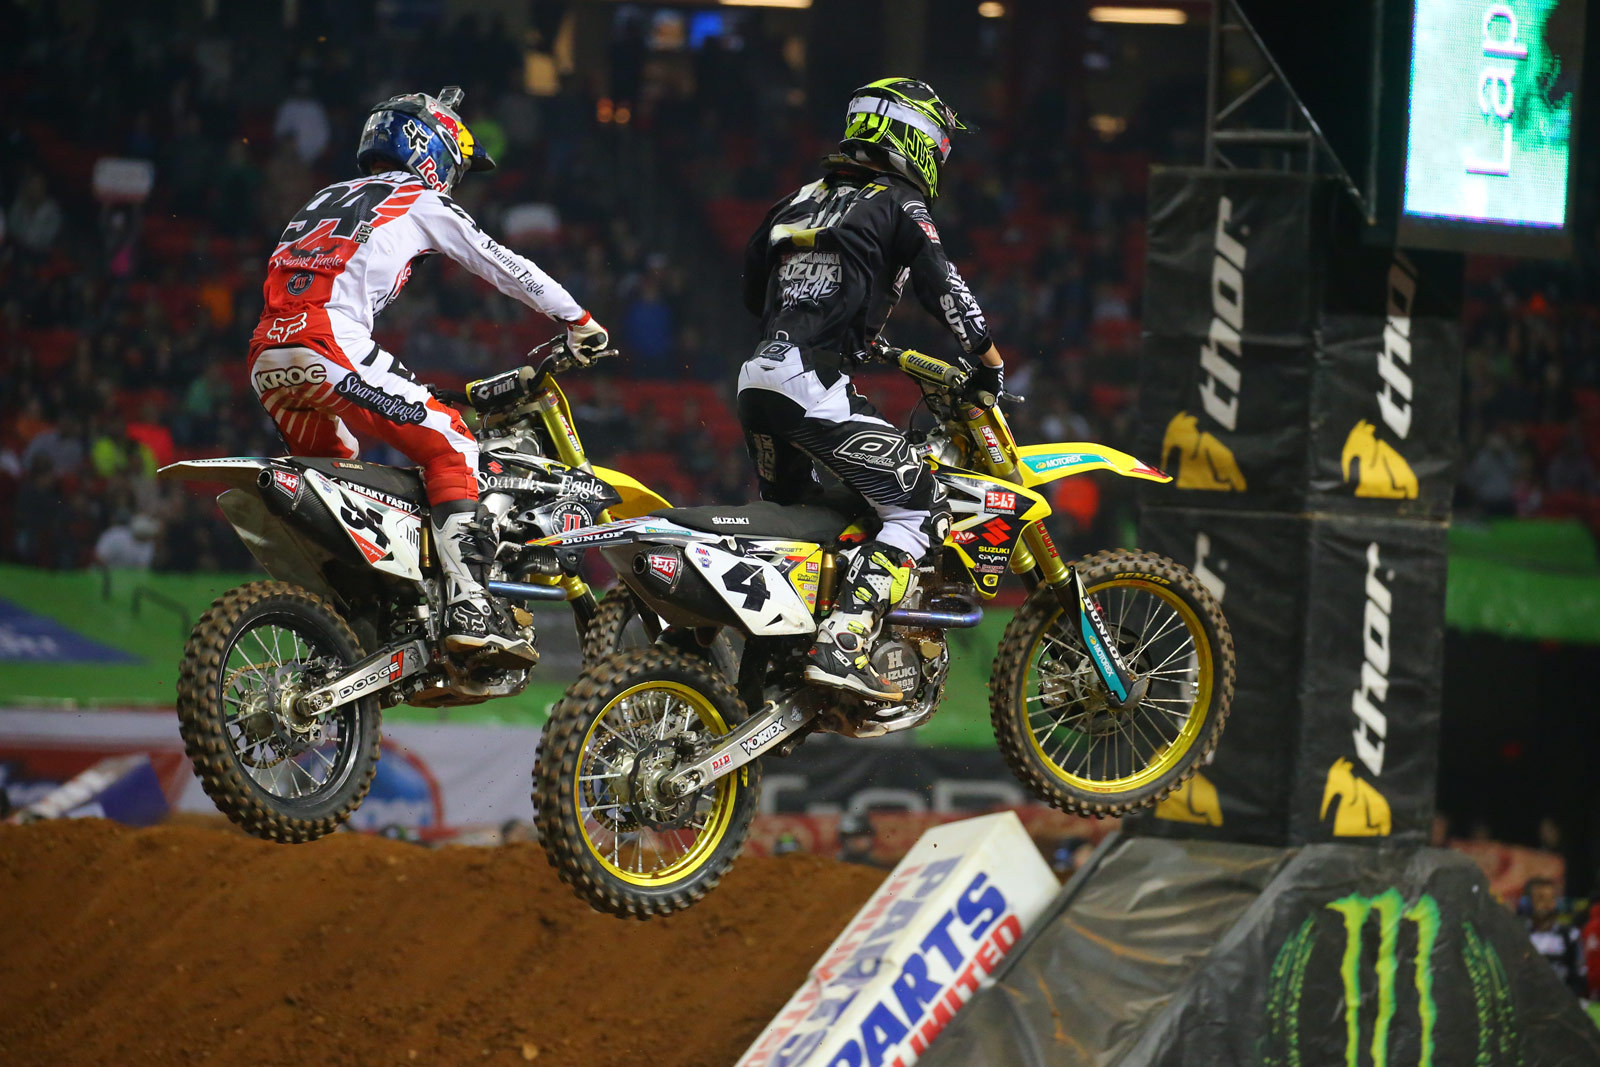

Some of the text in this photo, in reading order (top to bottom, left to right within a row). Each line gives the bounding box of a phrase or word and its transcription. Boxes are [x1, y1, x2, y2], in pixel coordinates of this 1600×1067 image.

[1463, 4, 1528, 177] Lap
[311, 253, 344, 271] Eagle
[481, 239, 545, 298] Soaring Eagle
[777, 263, 843, 283] SUZUKI
[1200, 196, 1248, 431] thor
[254, 363, 328, 393] KROC
[338, 375, 425, 422] Soaring Eagle
[1045, 454, 1083, 468] MOTOREX
[347, 481, 413, 513] FREAKY FAST!
[555, 475, 603, 499] Eagle
[711, 516, 750, 525] SUZUKI
[561, 531, 624, 546] DUNLOP
[978, 545, 1010, 555] SUZUKI
[720, 560, 771, 613] 4
[1082, 596, 1127, 672] DUNLOP
[881, 666, 918, 681] UZUKI
[1092, 643, 1115, 678] MOTOREX
[1352, 541, 1393, 777] thor
[338, 661, 401, 699] DODGE
[740, 716, 787, 756] VORTEX
